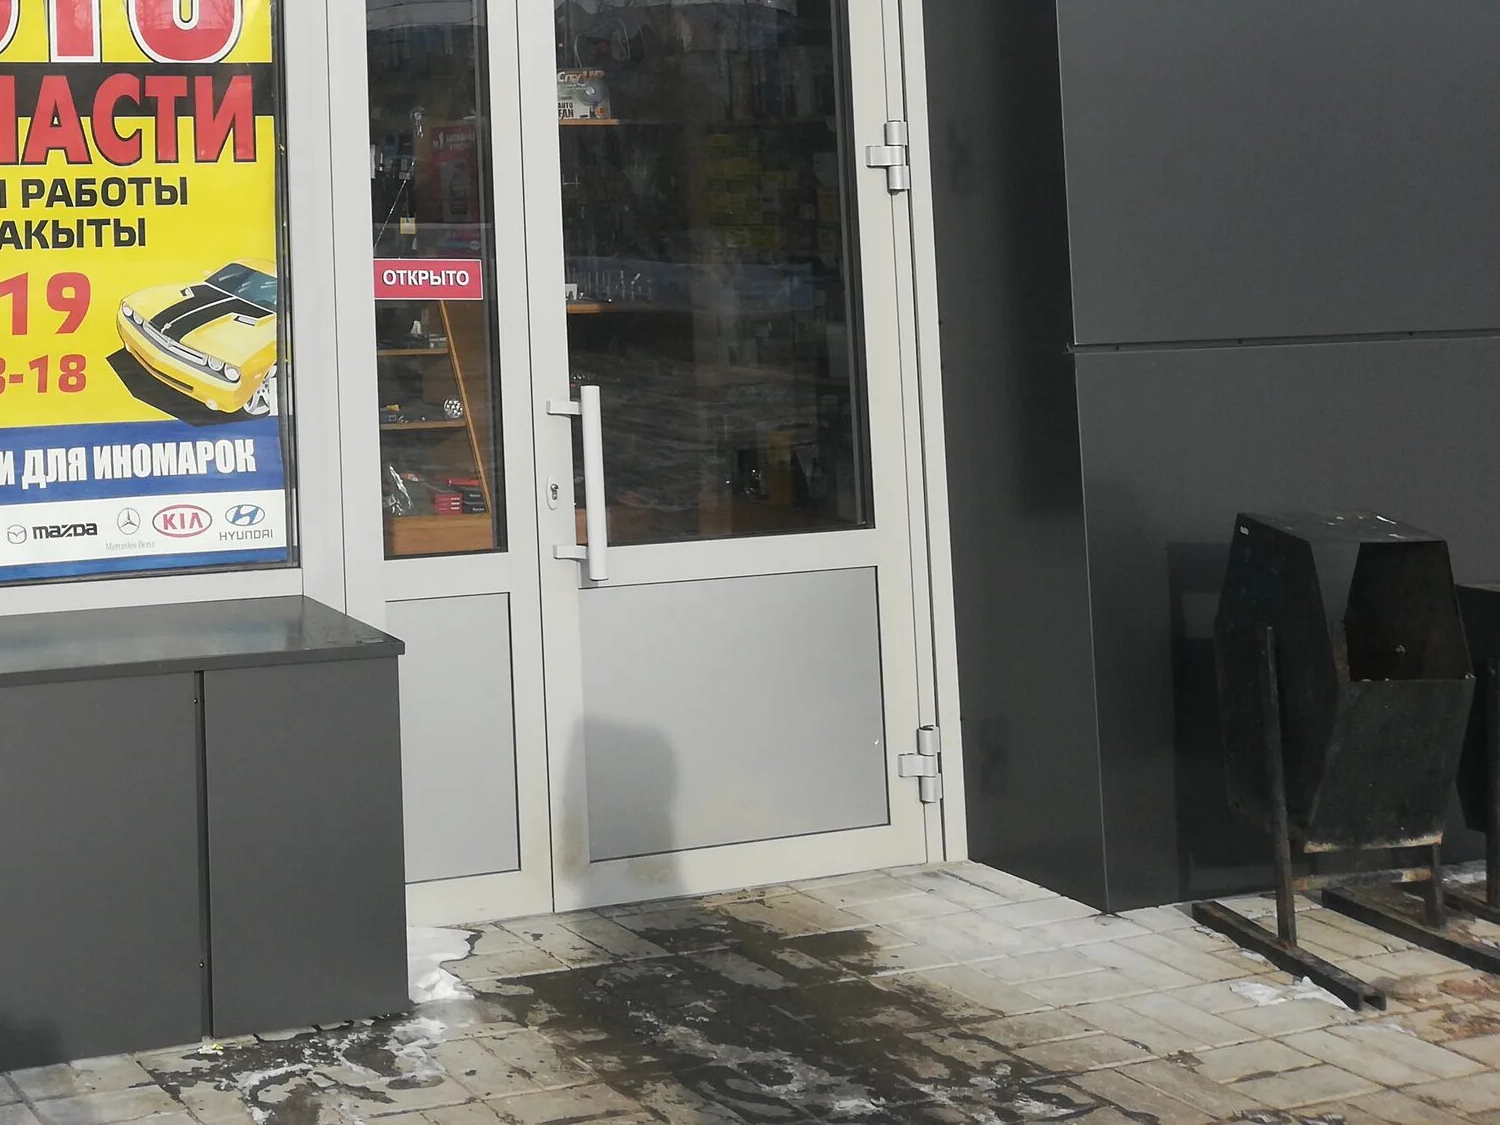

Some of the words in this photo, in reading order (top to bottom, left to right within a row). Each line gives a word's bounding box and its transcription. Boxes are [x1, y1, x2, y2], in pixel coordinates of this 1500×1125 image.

[21, 176, 188, 209] РАБОТЫ
[382, 269, 469, 287] ОТКРЫТО
[22, 447, 87, 490] ДЛЯ
[93, 439, 257, 480] ИНОМАРОК
[163, 513, 203, 530] KIA
[219, 529, 273, 541] HYUNDAI
